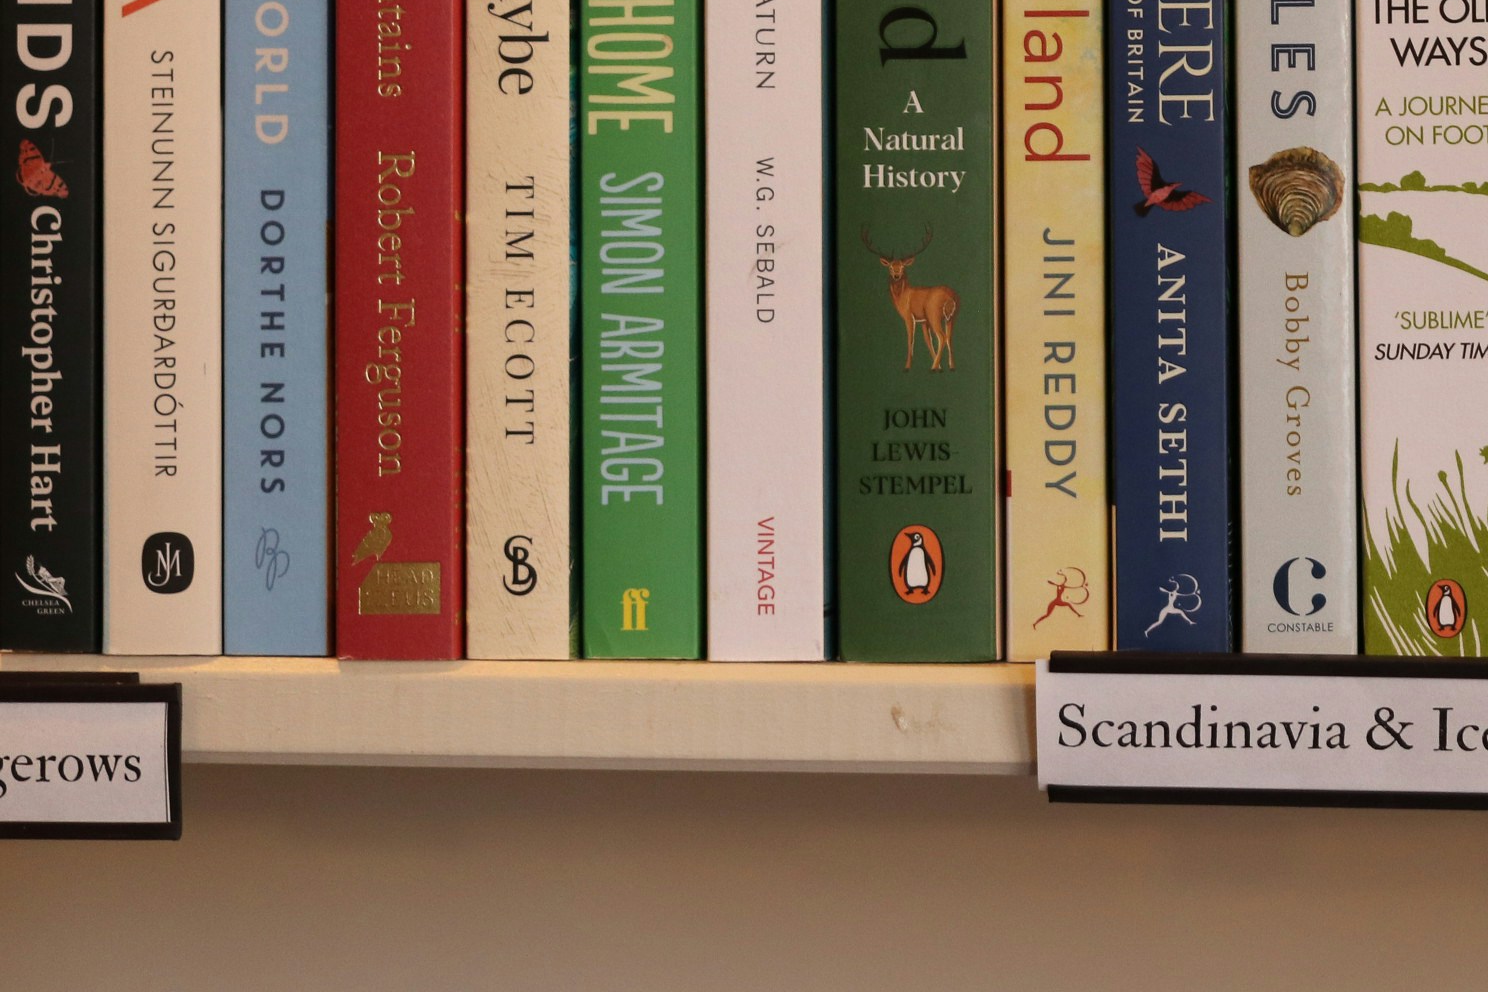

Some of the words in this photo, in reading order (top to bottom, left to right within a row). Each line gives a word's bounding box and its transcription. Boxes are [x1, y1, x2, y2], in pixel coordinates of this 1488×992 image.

[1127, 29, 1144, 123] BRITAIN
[1390, 36, 1488, 67] WAYS
[151, 50, 174, 209] STEINUNN
[863, 127, 964, 152] Natural
[902, 90, 924, 114] A
[1375, 97, 1393, 117] A
[1385, 125, 1424, 146] ON
[377, 150, 415, 285] Robert
[505, 175, 534, 260] TIM
[756, 157, 775, 211] W.G.
[862, 164, 965, 194] History
[260, 189, 285, 359] DORTHE
[600, 171, 664, 293] SIMON
[756, 224, 775, 324] SEBALD
[1043, 228, 1075, 316] JINI
[21, 205, 63, 436] Christopher
[1157, 243, 1188, 384] ANITA
[1276, 272, 1309, 372] Bobby
[1374, 342, 1455, 361] SUNDAY
[366, 299, 415, 478] Ferguson
[505, 288, 534, 444] ECOTT
[601, 313, 664, 505] ARMITAGE
[260, 382, 285, 494] NORS
[871, 442, 958, 463] LEWIS-
[883, 409, 946, 432] JOHN
[1043, 341, 1077, 499] REDDY
[1285, 385, 1311, 497] Groves
[30, 443, 62, 532] Hart
[859, 474, 973, 496] STEMPEL
[1159, 403, 1188, 542] SETHI
[22, 599, 60, 607] CHELSEA
[757, 516, 775, 616] VINTAGE
[1267, 622, 1334, 633] CONSTABLE
[1057, 702, 1349, 750] Scandinavia
[1365, 707, 1414, 750] &
